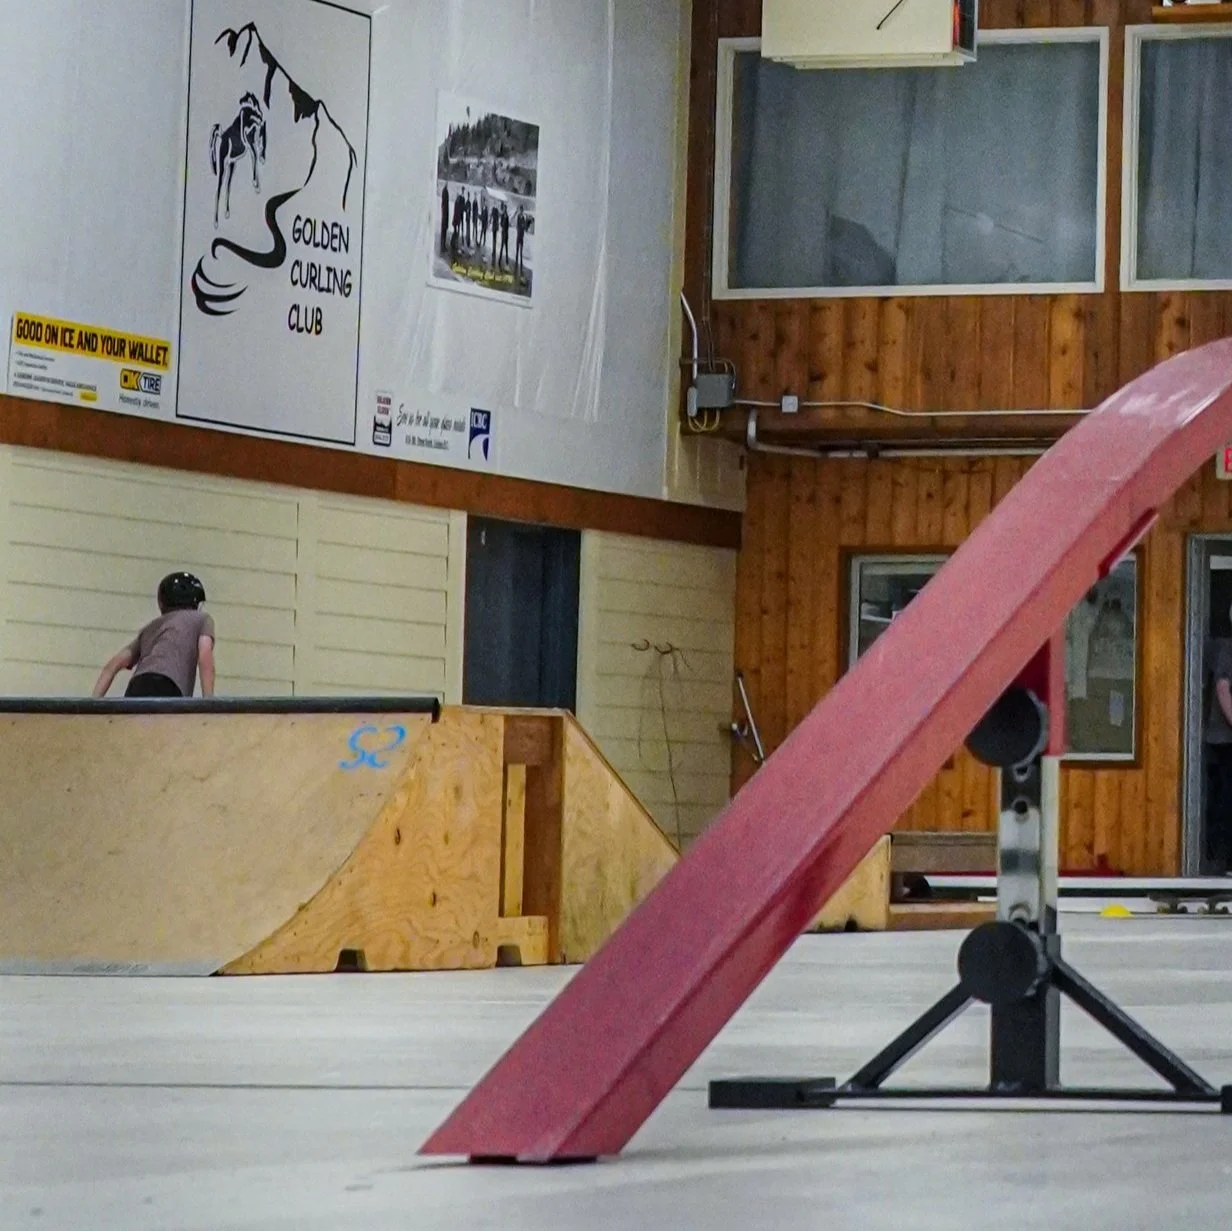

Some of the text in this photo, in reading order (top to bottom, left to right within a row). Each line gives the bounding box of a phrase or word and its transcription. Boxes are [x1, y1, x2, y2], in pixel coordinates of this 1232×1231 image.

[292, 214, 349, 254] GOLDEN
[290, 259, 352, 298] CURLING
[288, 303, 322, 336] CLUB
[16, 318, 169, 367] GOOD ON ICE AND YOUR WALLET.
[121, 368, 161, 392] OK TIRE
